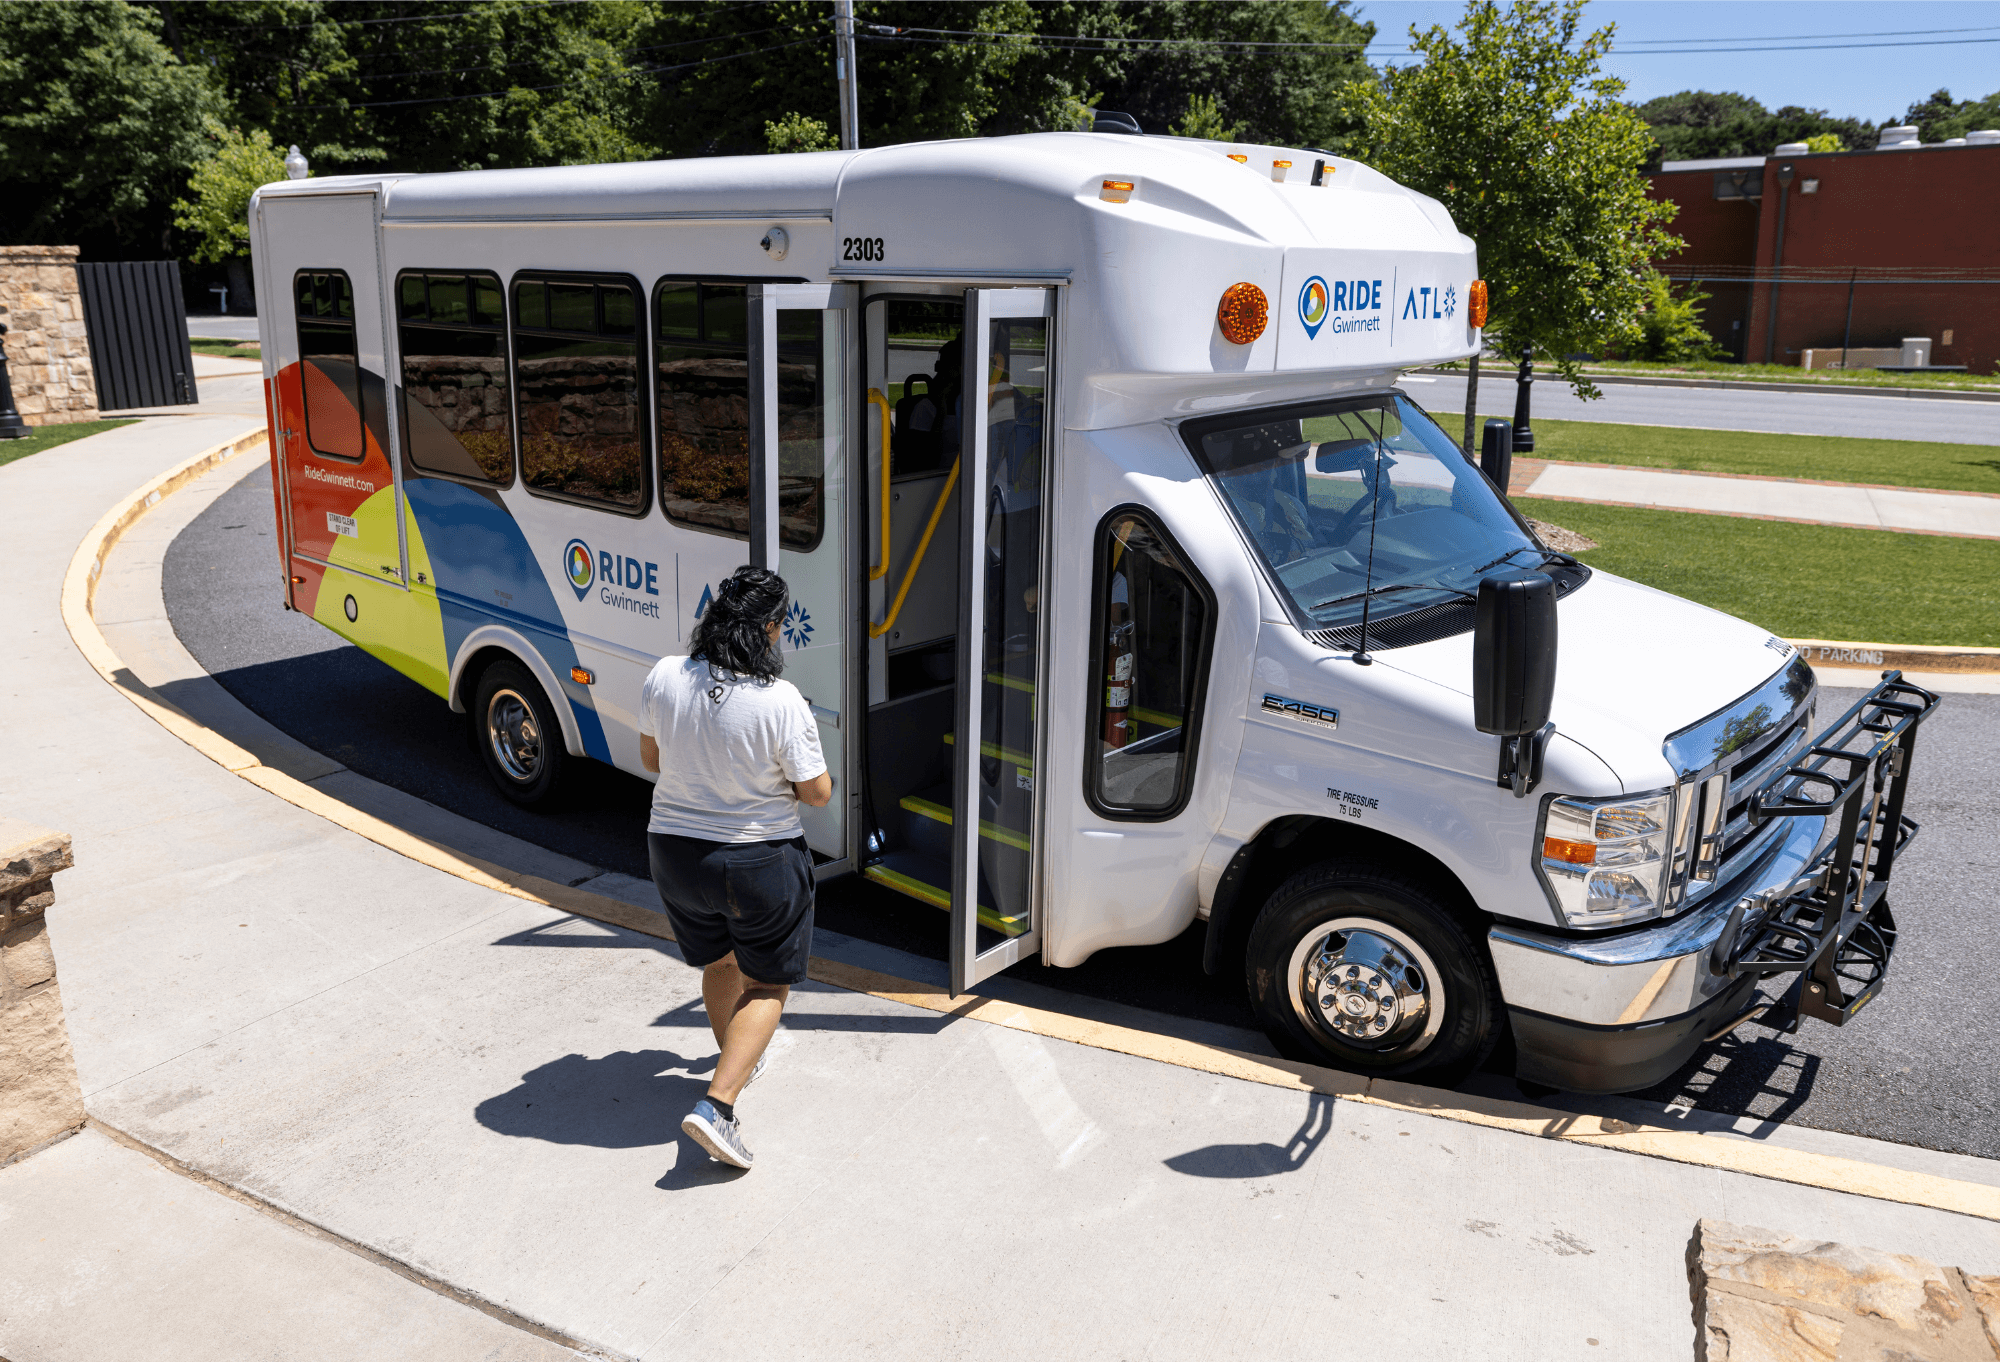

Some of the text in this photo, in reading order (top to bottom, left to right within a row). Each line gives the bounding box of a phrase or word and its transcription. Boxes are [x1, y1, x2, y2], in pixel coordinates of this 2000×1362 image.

[843, 237, 884, 261] 2303
[1333, 280, 1382, 311] RIDE
[1402, 287, 1441, 320] ATL
[1332, 316, 1381, 334] Gwinnett
[304, 465, 374, 493] RideGwinnett.com
[329, 513, 355, 527] STAND CLEAR
[599, 550, 659, 596] RIDE
[600, 587, 660, 620] Gwinnett
[1820, 647, 1884, 665] PARKING
[1327, 787, 1379, 809] TIRE PRESSURE
[1339, 803, 1361, 818] 75 LBS
